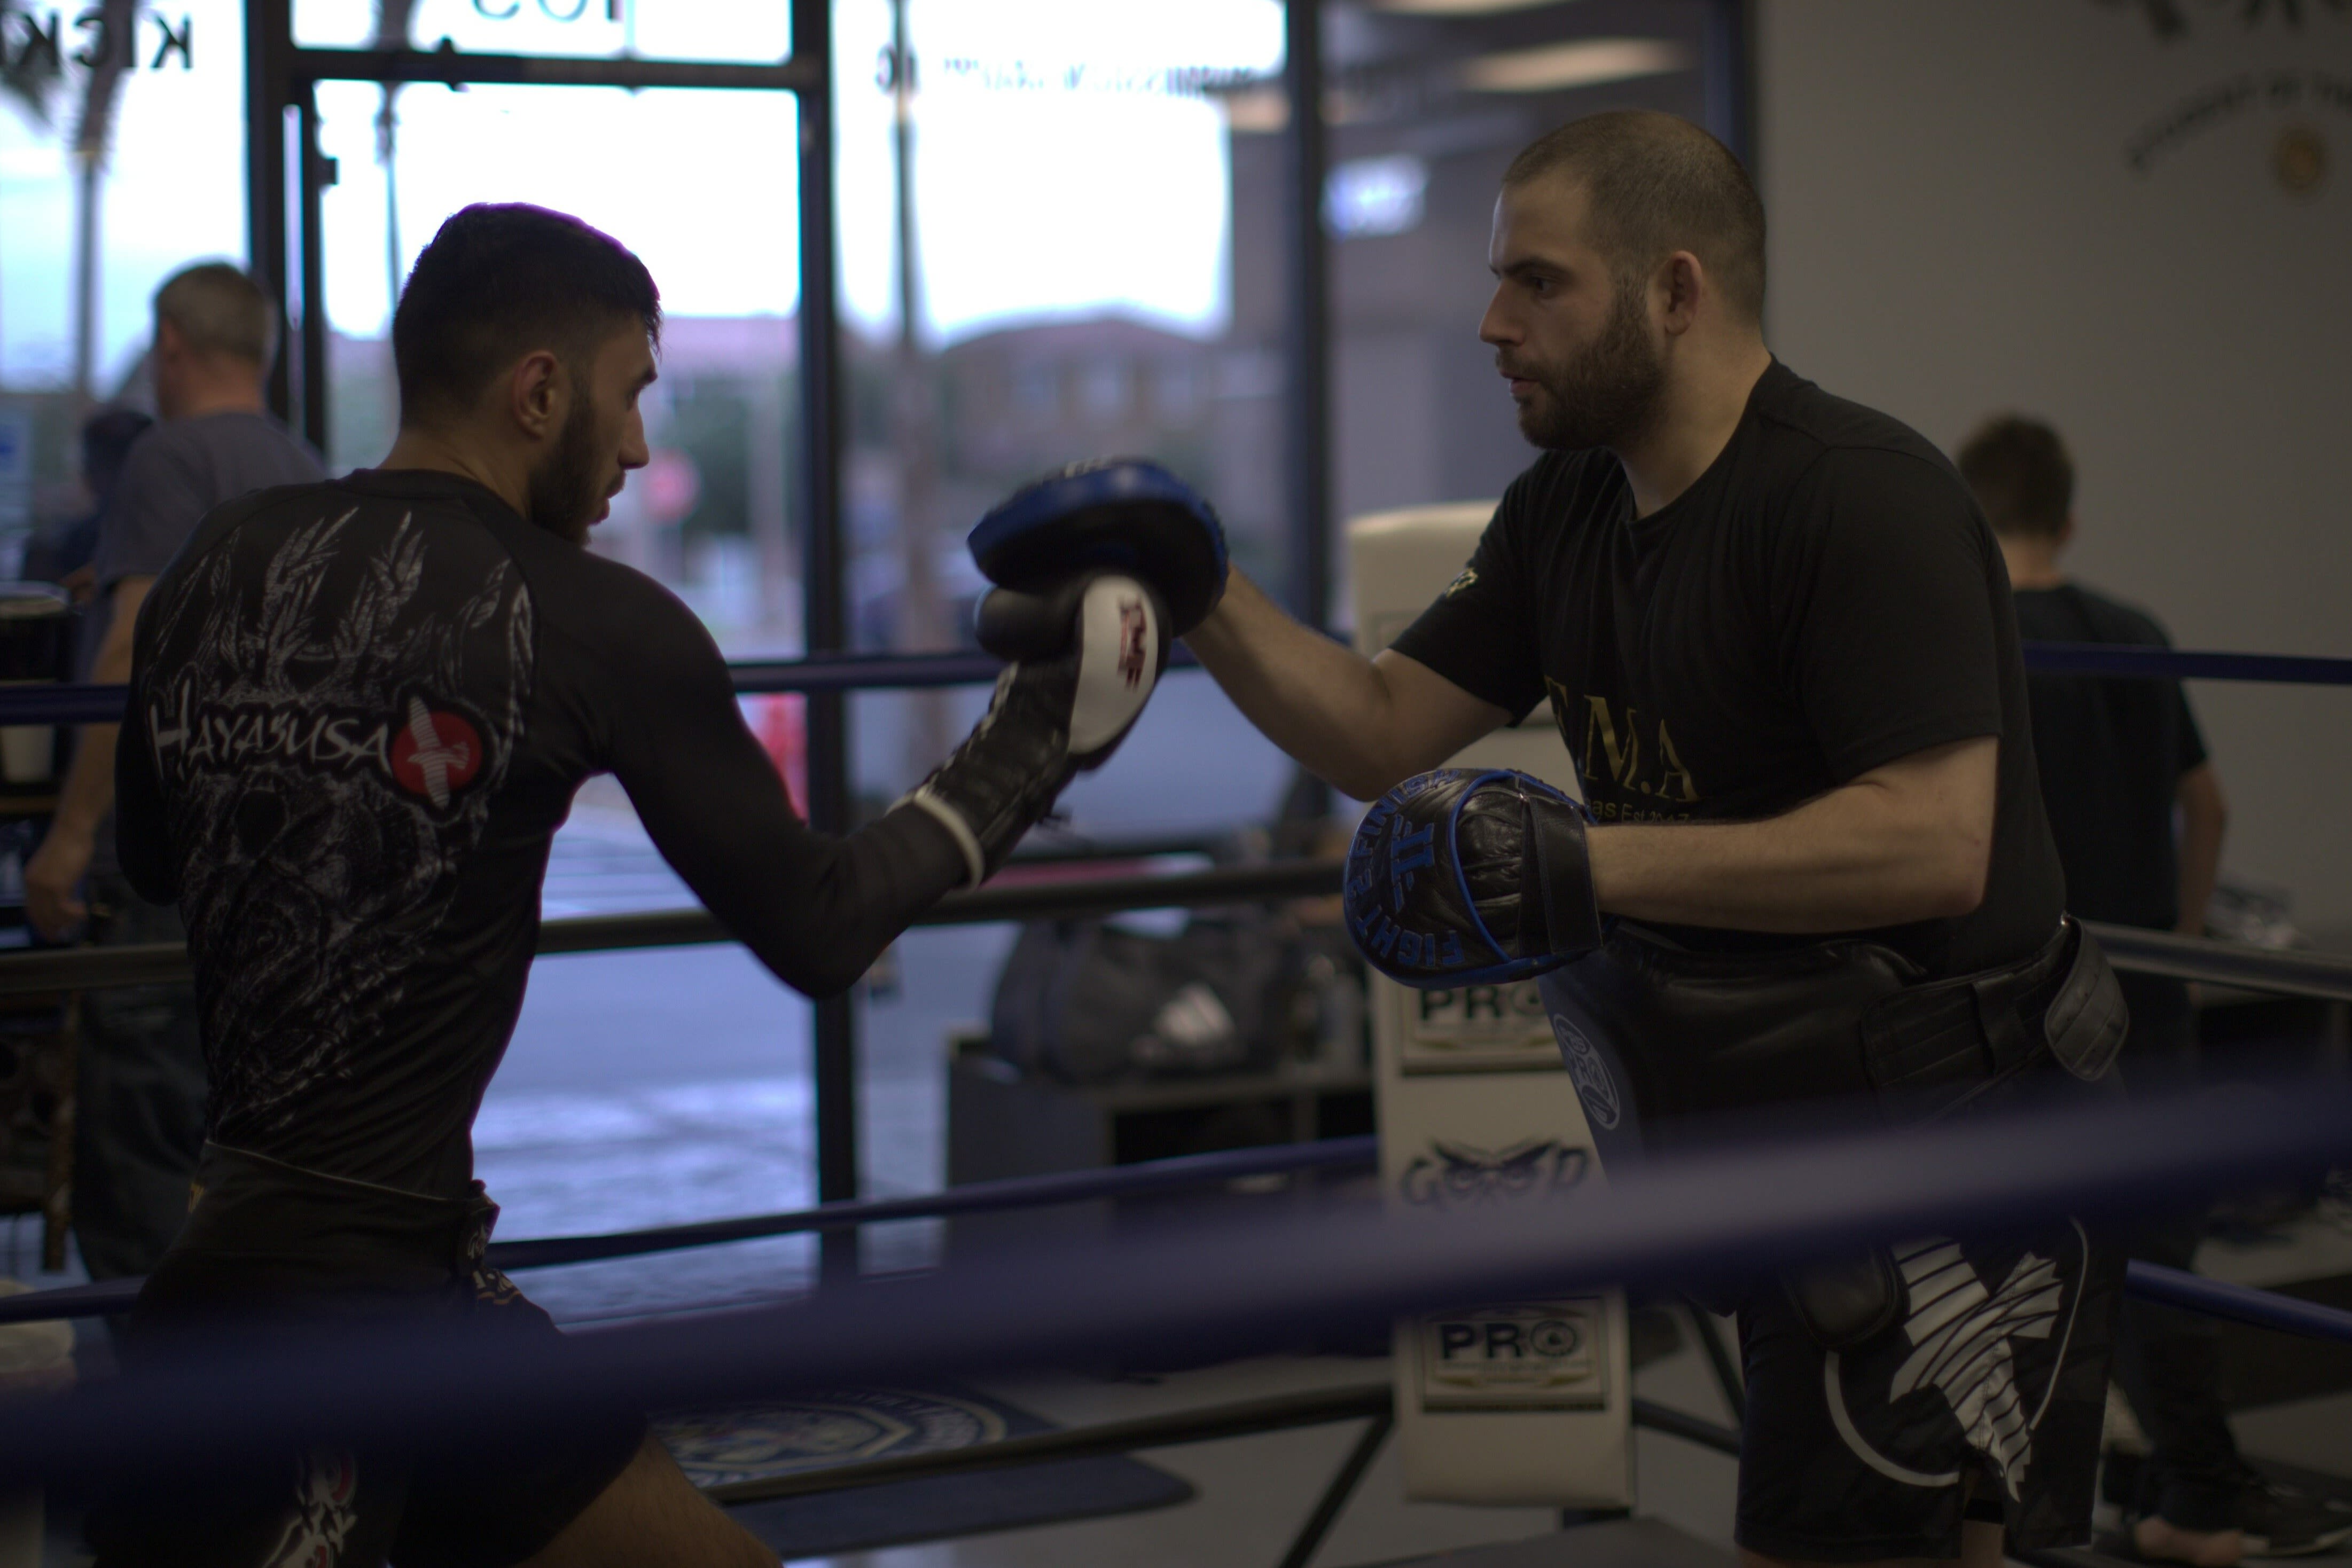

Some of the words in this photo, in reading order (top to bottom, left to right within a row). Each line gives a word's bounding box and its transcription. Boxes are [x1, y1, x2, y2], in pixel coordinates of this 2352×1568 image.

[150, 678, 393, 782] HAYABUSA
[1354, 770, 1462, 859] FINISH
[1348, 868, 1373, 901] 2
[1356, 904, 1465, 968] FIGHT
